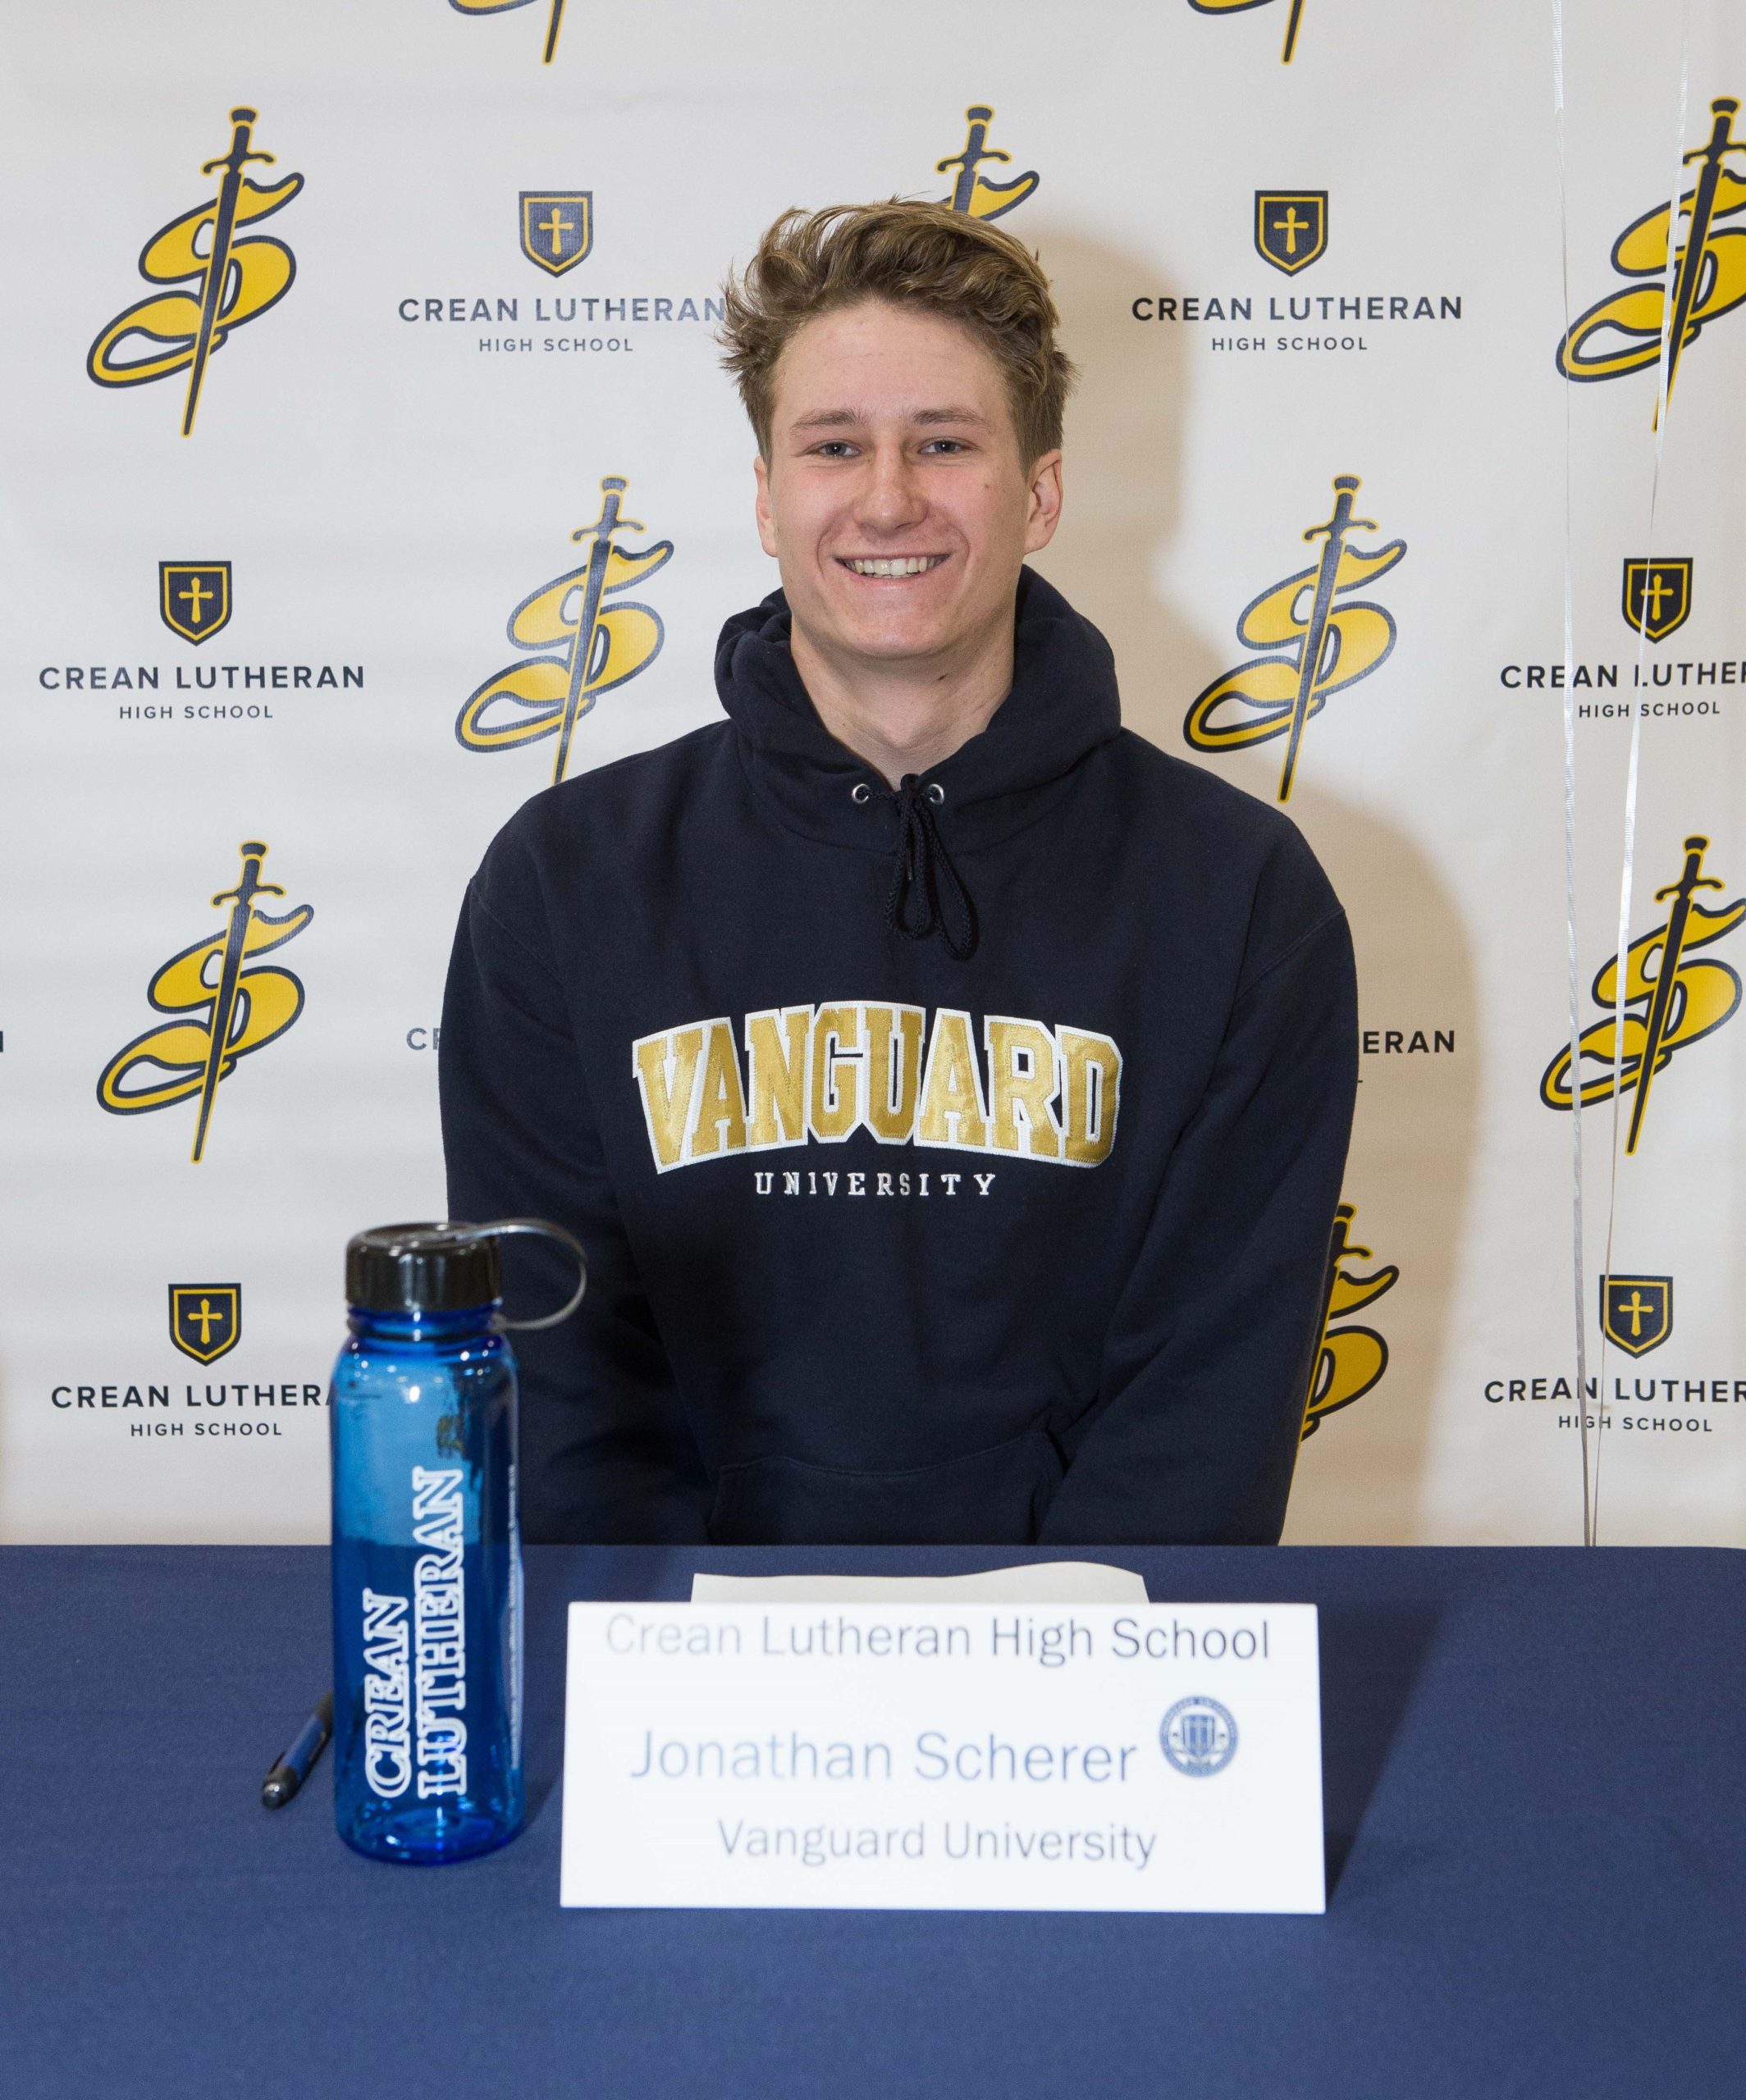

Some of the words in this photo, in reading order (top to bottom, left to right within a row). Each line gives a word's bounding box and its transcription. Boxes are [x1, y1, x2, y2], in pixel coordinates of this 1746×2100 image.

[398, 298, 518, 322] CREAN
[535, 297, 726, 322] LUTHERAN
[1131, 297, 1251, 322] CREAN
[1269, 296, 1462, 321] LUTHERAN
[479, 338, 532, 352] HIGH
[543, 337, 633, 353] SCHOOL
[1212, 337, 1266, 351] HIGH
[1277, 336, 1368, 351] SCHOOL
[39, 666, 159, 691] CREAN
[176, 665, 364, 690] LUTHERAN
[1500, 664, 1618, 689] CREAN
[1634, 661, 1746, 687] LUTHE
[119, 705, 172, 719] HIGH
[184, 705, 273, 719] SCHOOL
[1579, 704, 1629, 719] HIGH
[1640, 701, 1721, 717] SCHOOL
[1362, 1029, 1455, 1054] ERAN
[632, 1000, 1123, 1175] VANGUARD
[754, 1171, 996, 1197] UNIVERSITY
[51, 1385, 170, 1409] CREAN
[185, 1384, 330, 1408] LUTHER
[1483, 1377, 1597, 1403] CREAN
[130, 1422, 184, 1437] HIGH
[194, 1422, 282, 1436] SCHOOL
[1558, 1415, 1611, 1429] HIGH
[1622, 1417, 1713, 1432] SCHOOL
[412, 1466, 468, 1799] LUTHERAN
[606, 1612, 742, 1655] Crean
[761, 1614, 971, 1659] Lutheran
[990, 1615, 1094, 1669] High
[1110, 1616, 1270, 1661] School
[363, 1588, 411, 1798] CREAN
[628, 1728, 893, 1782] Jonathan
[913, 1729, 1139, 1784] Scherer
[716, 1819, 926, 1868] Vanguard
[944, 1819, 1159, 1872] University
